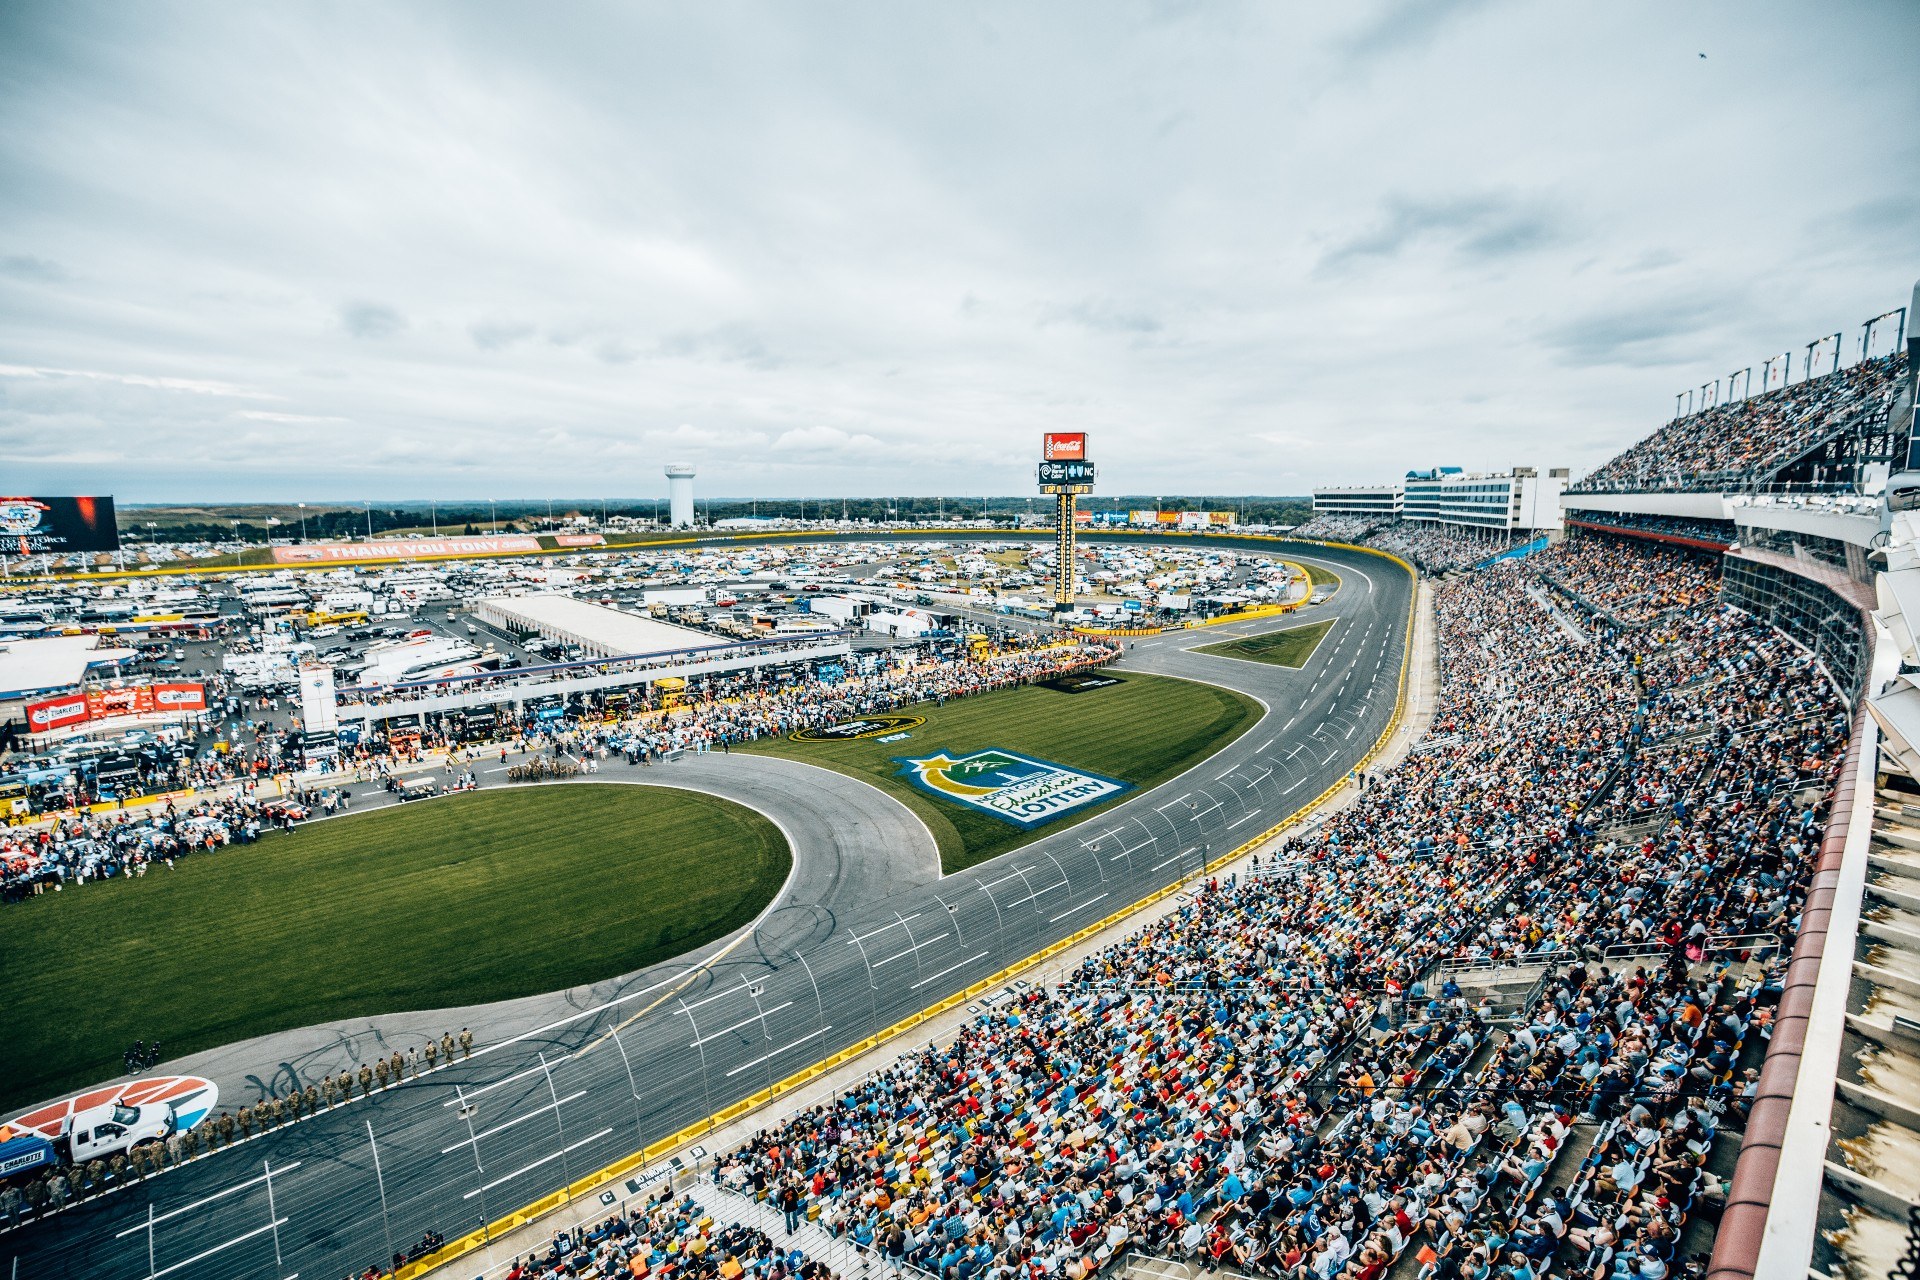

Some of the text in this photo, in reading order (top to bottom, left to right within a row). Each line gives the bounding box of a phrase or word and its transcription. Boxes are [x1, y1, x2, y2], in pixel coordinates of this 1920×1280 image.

[1084, 467, 1094, 476] NC
[1044, 486, 1055, 494] LAP
[1072, 486, 1082, 494] LAP
[326, 545, 401, 558] THANK
[403, 542, 446, 554] YOU
[448, 540, 499, 552] TONY
[975, 787, 1013, 803] NORTH
[990, 776, 1082, 810] Education
[1008, 780, 1105, 818] LOTTERY
[4, 1151, 42, 1169] CHARLOTTE
[601, 1192, 612, 1203] C
